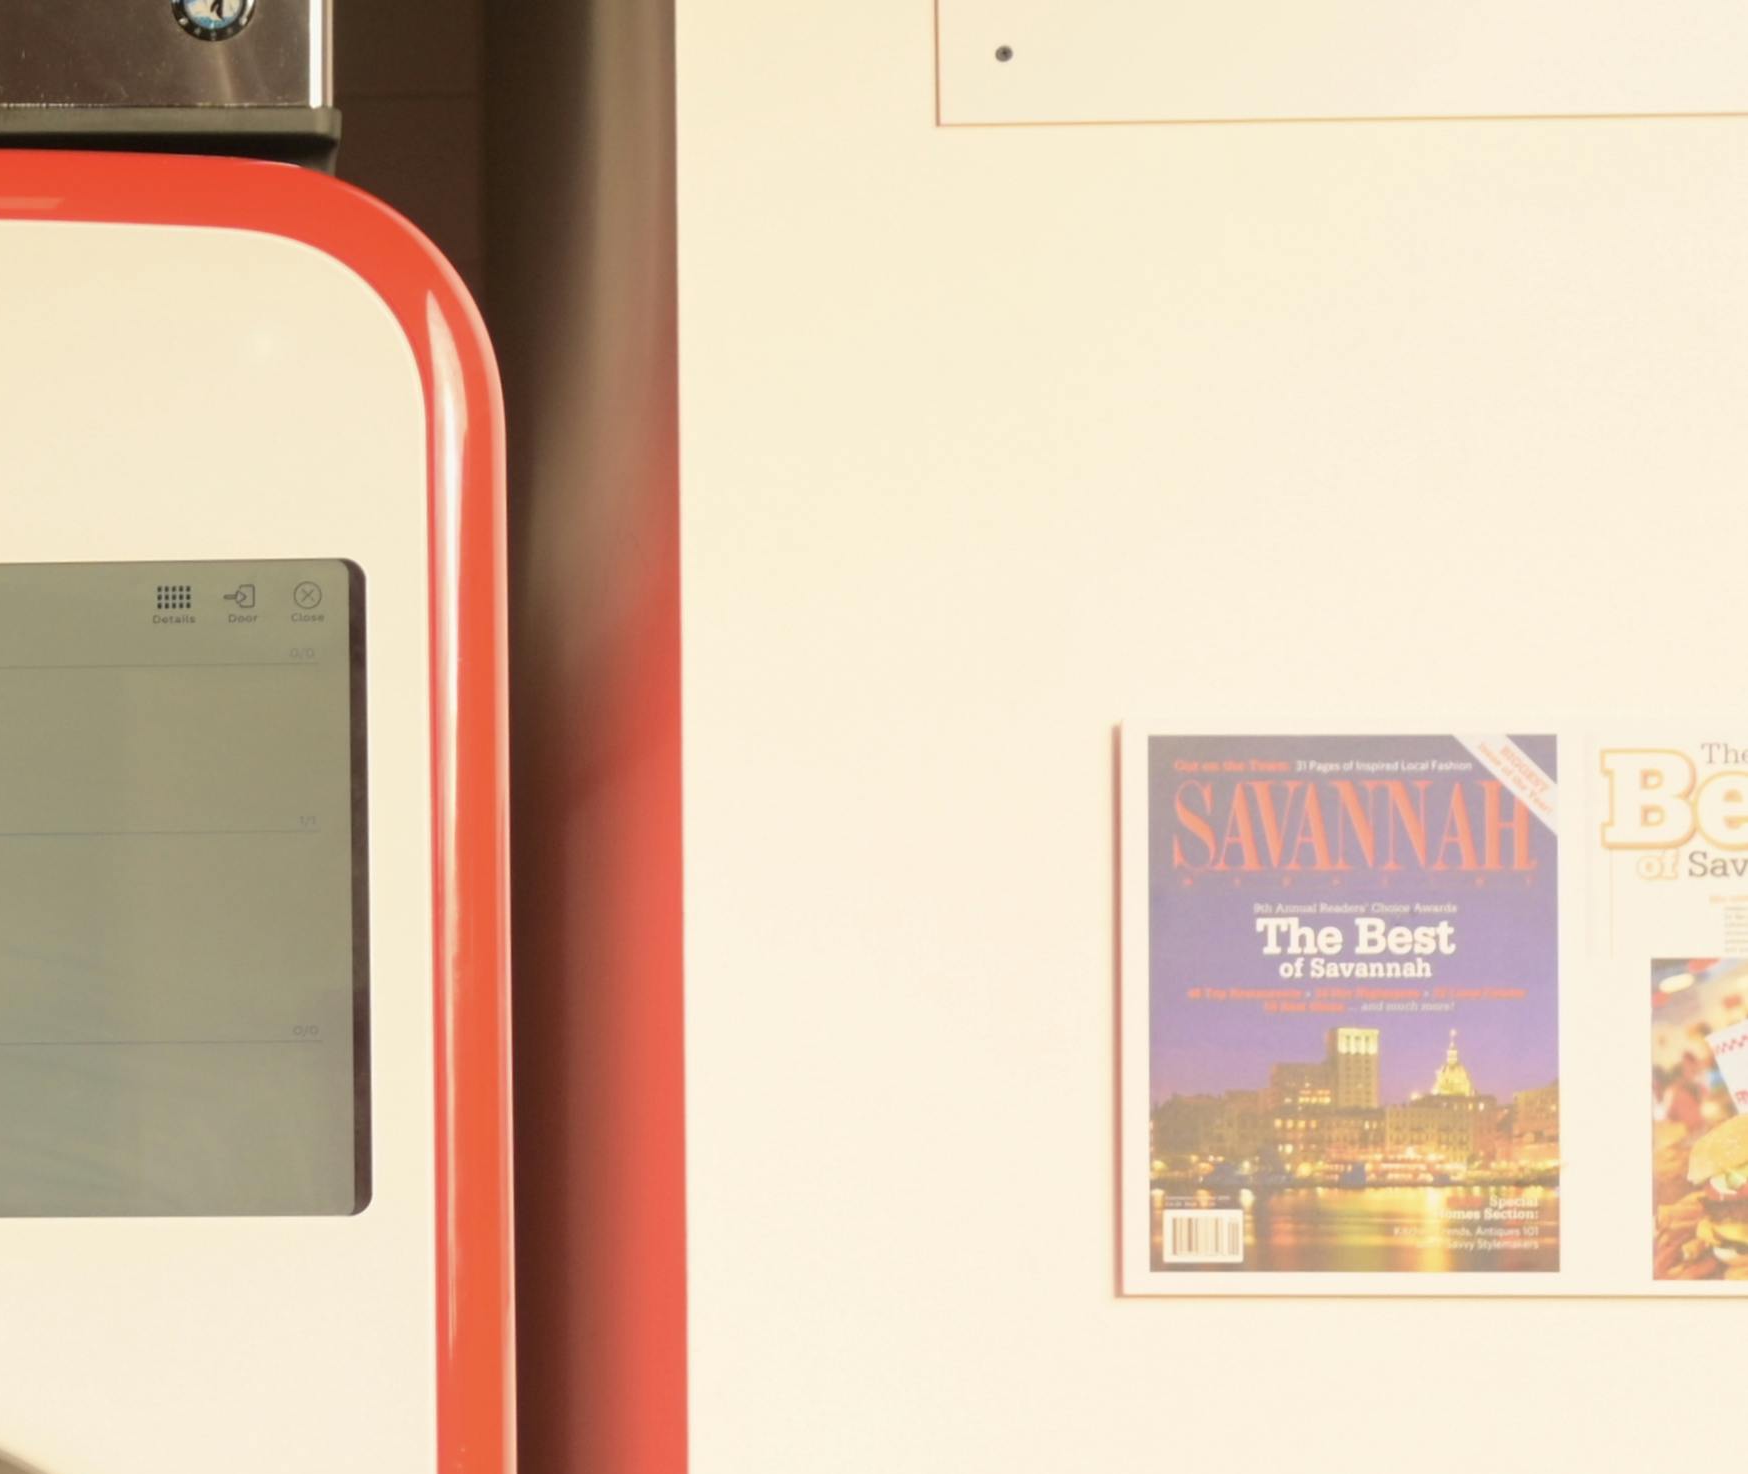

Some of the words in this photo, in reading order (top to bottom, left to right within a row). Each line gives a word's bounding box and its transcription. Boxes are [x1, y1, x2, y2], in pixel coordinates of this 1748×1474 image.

[152, 614, 196, 624] Details
[227, 613, 258, 623] Door
[290, 612, 325, 622] Close
[1309, 760, 1341, 773] Pages
[1343, 759, 1354, 771] of
[1356, 759, 1400, 773] Inspired
[1401, 759, 1429, 771] Local
[1432, 759, 1473, 771] Fashion
[1600, 748, 1748, 851] Be
[1172, 778, 1537, 873] SAVANNAH
[1276, 903, 1317, 914] Annual
[1371, 903, 1410, 914] Choice
[1414, 903, 1458, 914] Awards
[1254, 916, 1343, 955] The
[1355, 916, 1457, 955] Best
[1279, 957, 1305, 978] of
[1310, 957, 1433, 979] Savannah
[1489, 1195, 1538, 1209] Special
[1483, 1207, 1539, 1220] Section:
